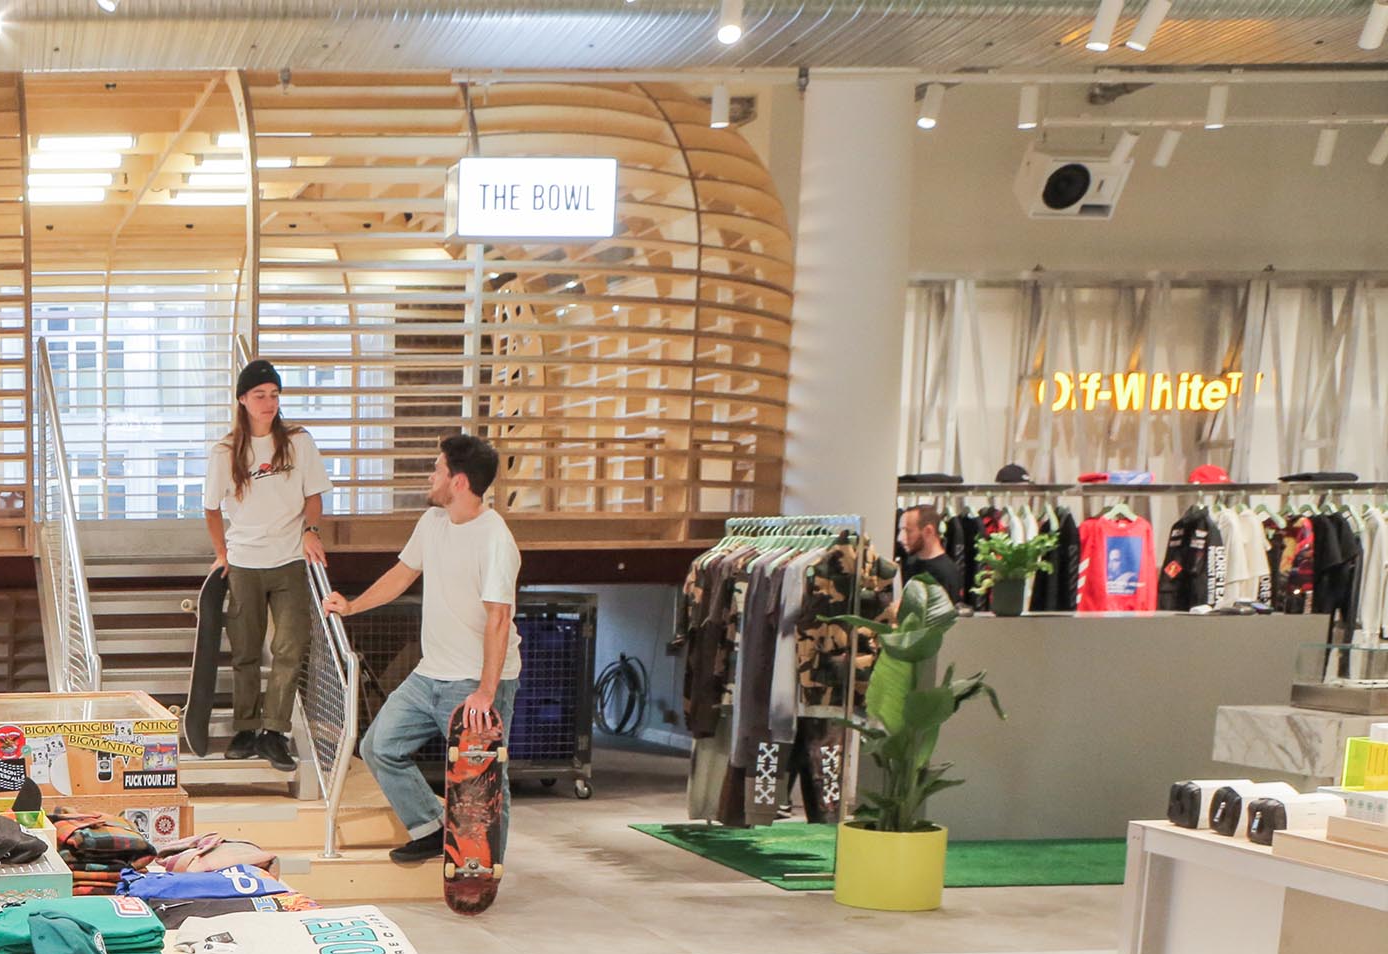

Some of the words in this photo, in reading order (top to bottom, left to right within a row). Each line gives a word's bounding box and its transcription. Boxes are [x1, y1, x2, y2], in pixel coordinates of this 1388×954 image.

[479, 184, 521, 211] THE
[533, 184, 595, 211] BOWL
[125, 775, 143, 787] FUCK
[143, 774, 161, 786] YOUR
[162, 772, 176, 786] LIFE
